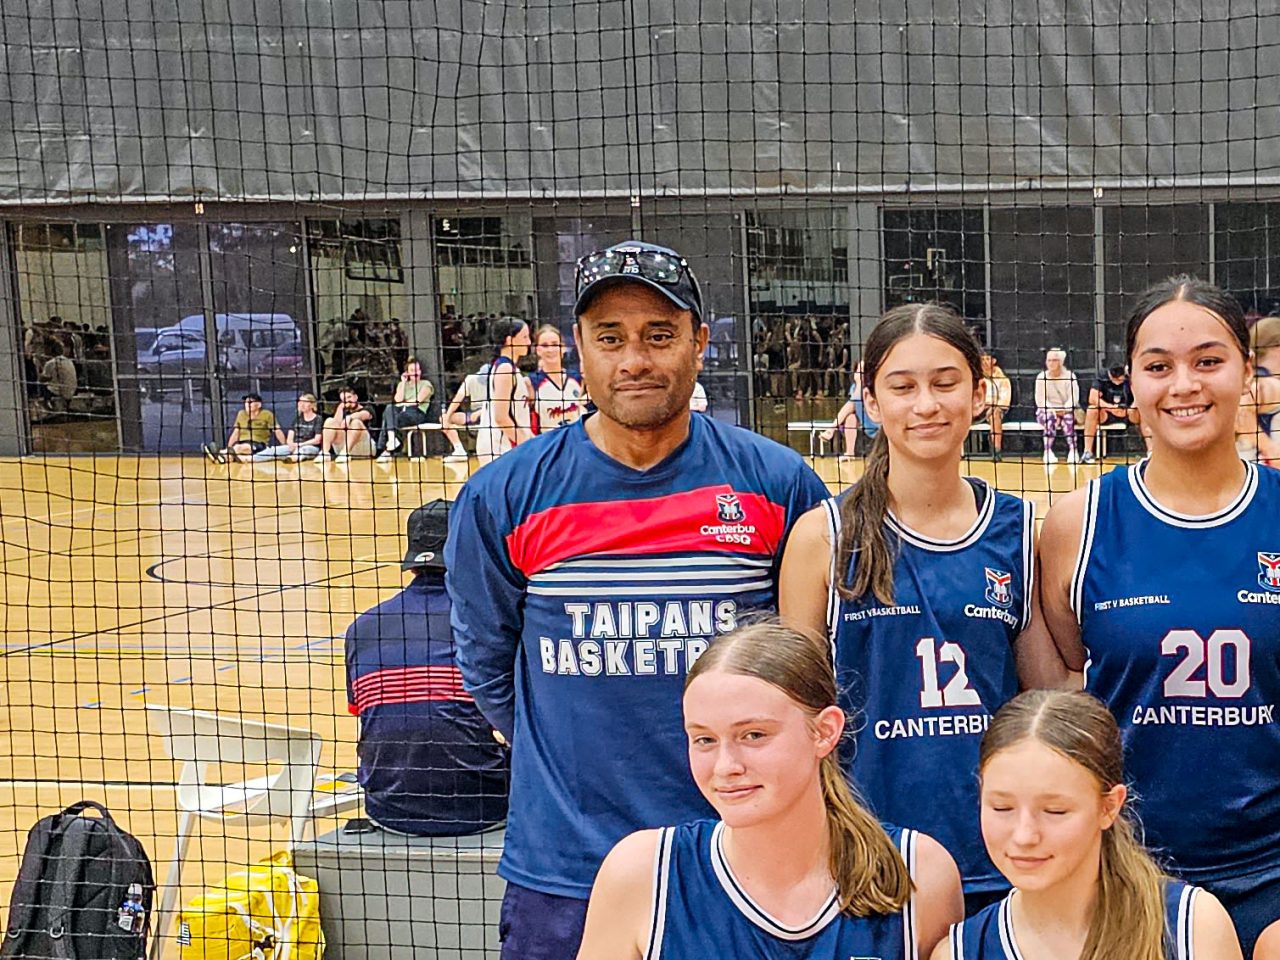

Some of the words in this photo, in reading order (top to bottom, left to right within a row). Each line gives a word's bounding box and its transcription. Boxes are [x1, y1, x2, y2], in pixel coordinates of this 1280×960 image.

[564, 600, 737, 638] TAIPANS
[964, 604, 1019, 629] Canterbury
[1112, 599, 1118, 608] V
[1119, 595, 1171, 607] BASKETBALL
[915, 637, 982, 708] 12
[1160, 628, 1251, 698] 20
